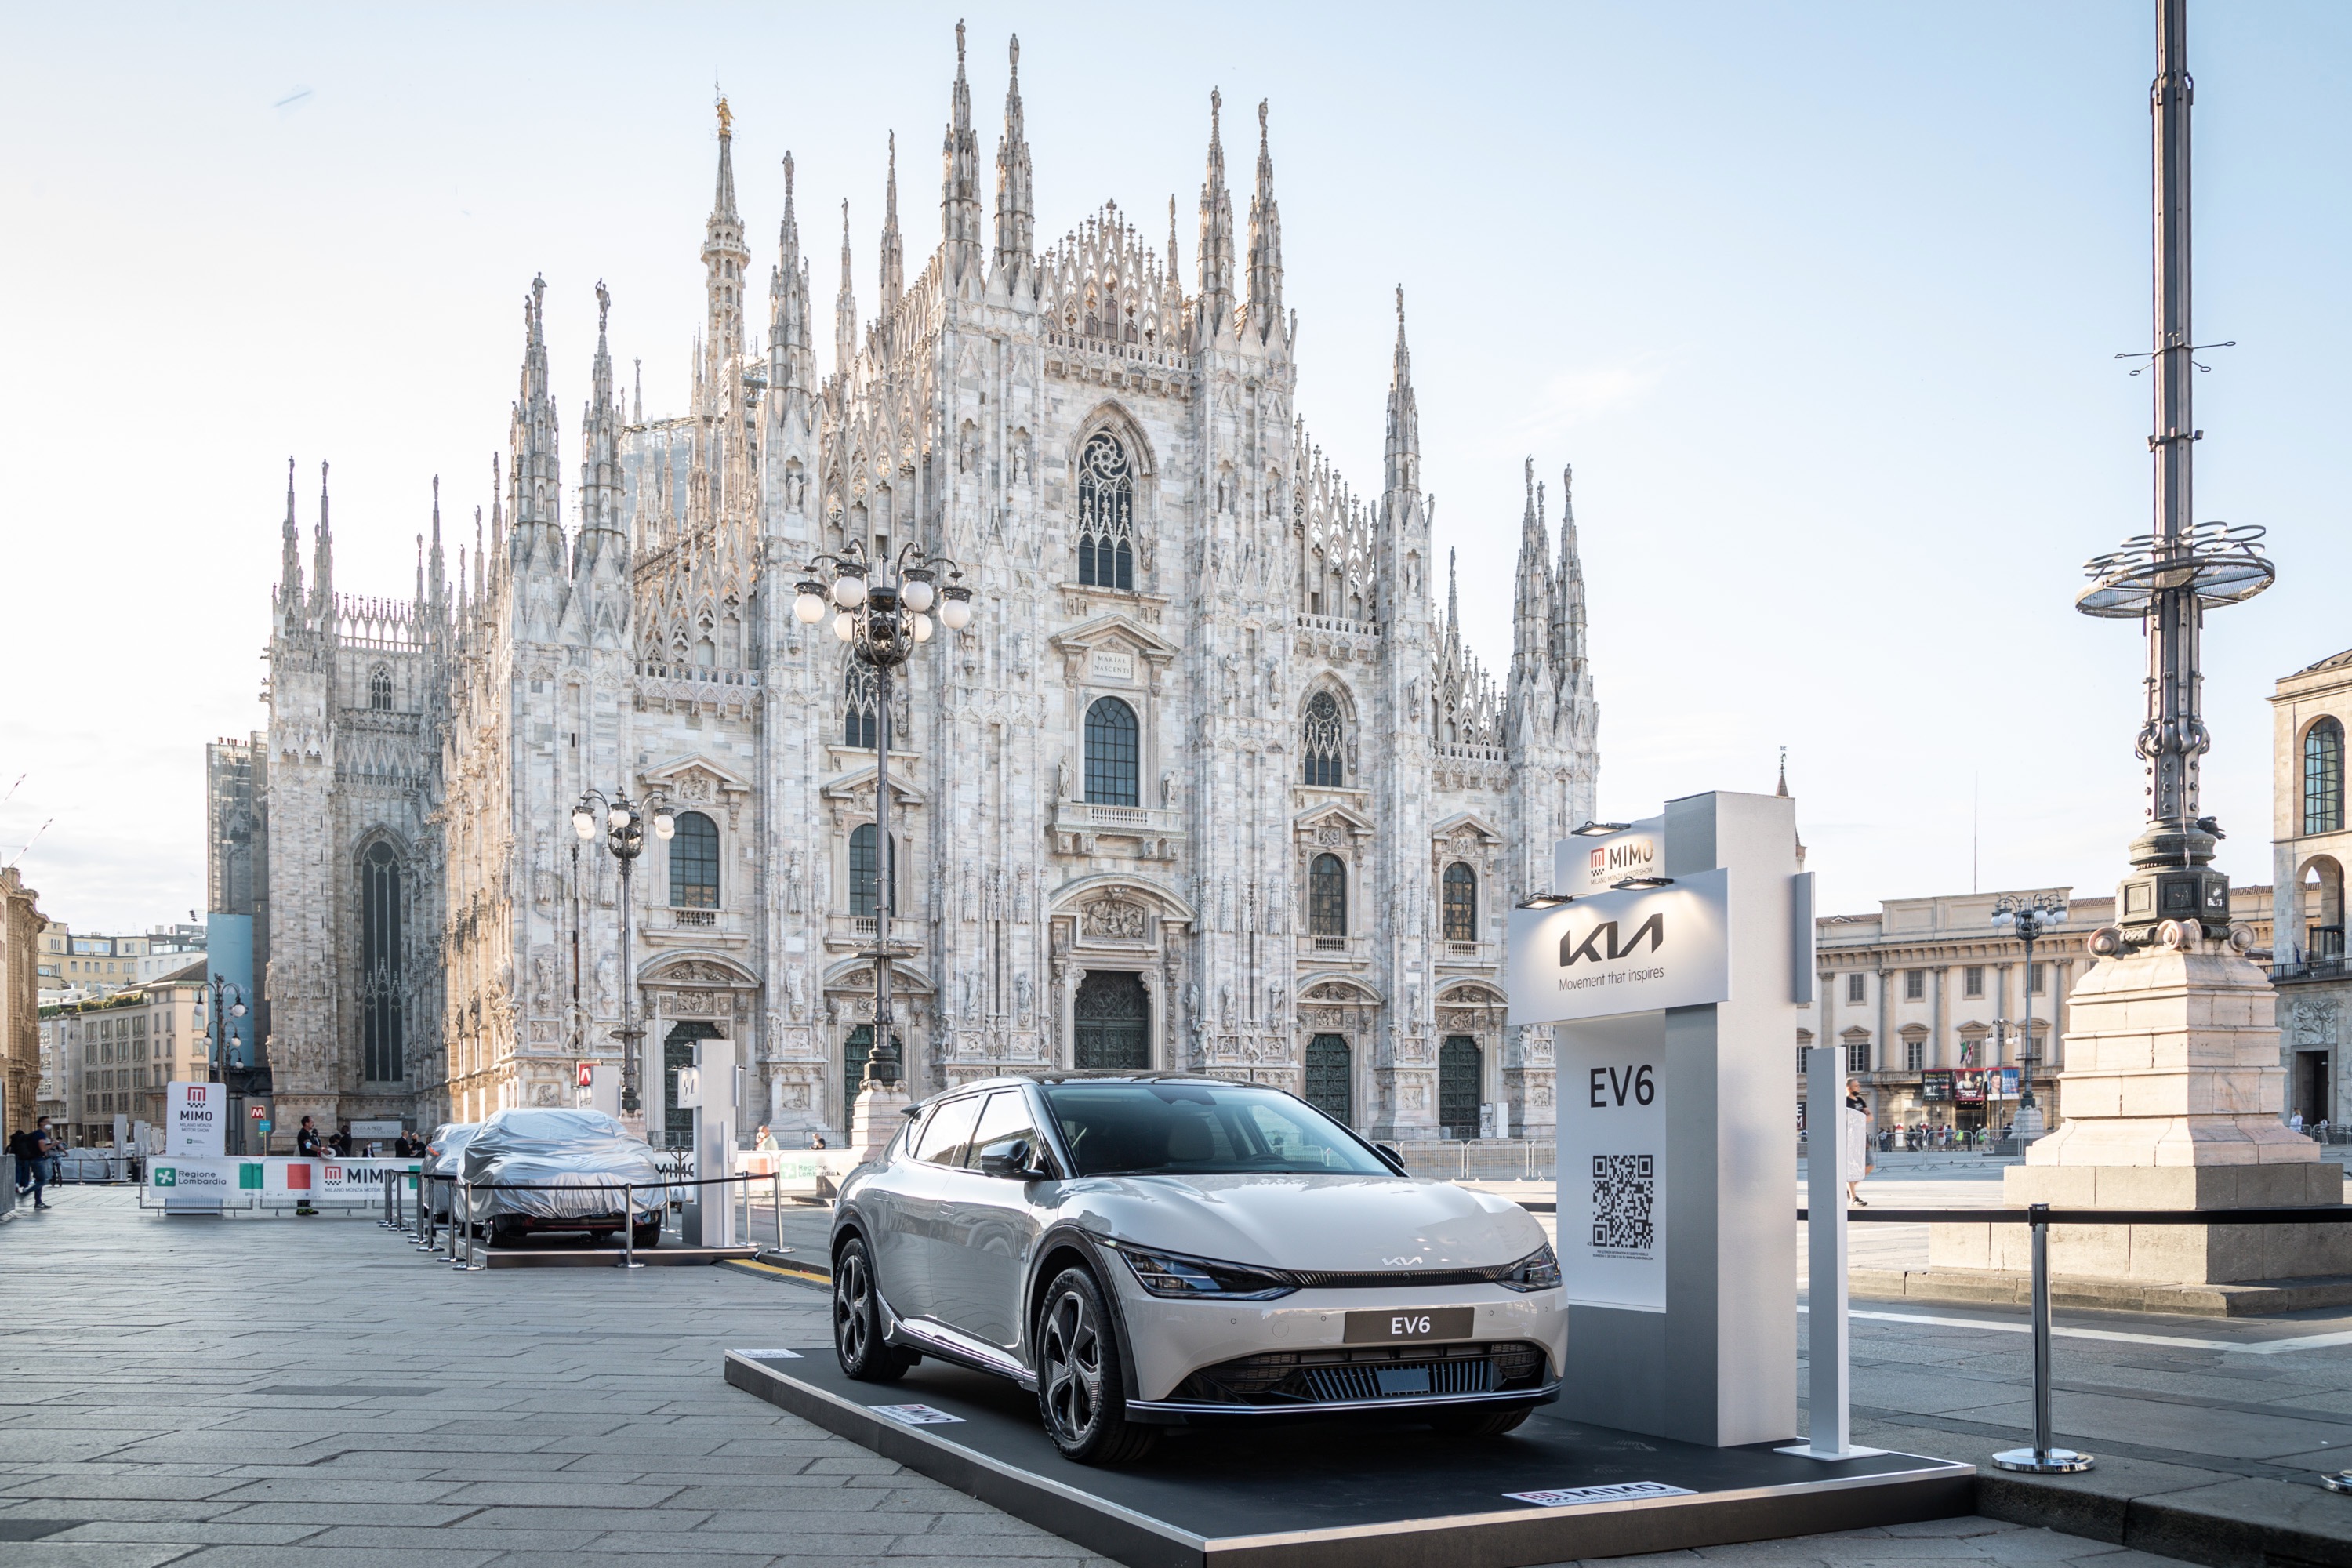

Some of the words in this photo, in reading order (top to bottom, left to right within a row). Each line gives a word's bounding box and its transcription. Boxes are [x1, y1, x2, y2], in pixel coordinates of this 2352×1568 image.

[1094, 665, 1130, 674] NASCENTI
[1610, 840, 1653, 869] MIMO
[1639, 866, 1653, 876] SHOW
[1559, 913, 1664, 967] KIA
[1559, 974, 1606, 991] Movement
[1608, 971, 1626, 985] that
[1628, 967, 1664, 983] inspires
[1590, 1064, 1655, 1108] EV6
[180, 1110, 212, 1121] MIMO
[252, 1108, 263, 1116] M
[1381, 1256, 1423, 1265] KIA
[1391, 1316, 1431, 1334] EV6
[1562, 1484, 1667, 1497] MIMO
